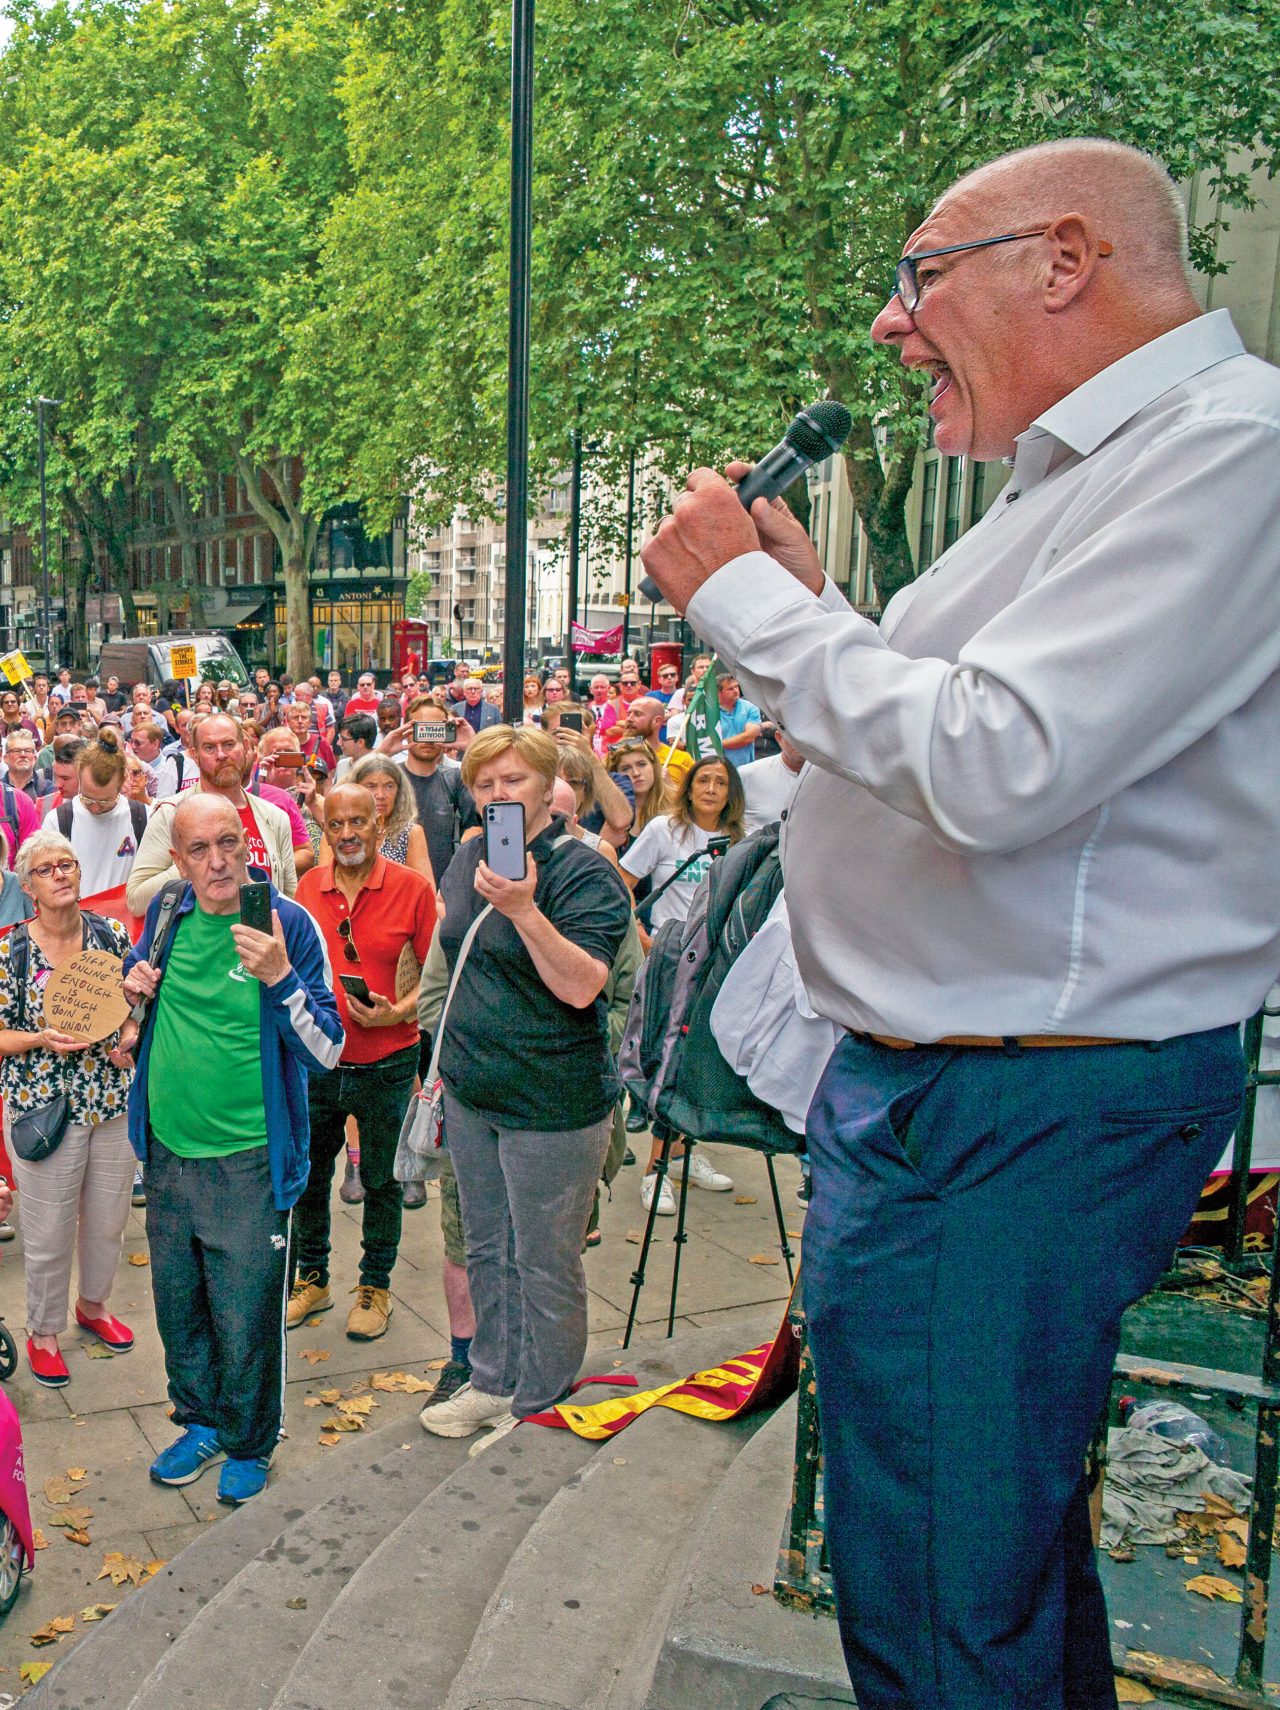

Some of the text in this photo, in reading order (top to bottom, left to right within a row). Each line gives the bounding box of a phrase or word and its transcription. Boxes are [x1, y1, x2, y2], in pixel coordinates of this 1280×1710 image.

[70, 962, 111, 981] ONLINE
[60, 974, 112, 999] ENOUGH
[68, 988, 78, 997] IS
[52, 992, 98, 1012] ENOUGH
[51, 1004, 91, 1022] JOIN A
[60, 1021, 92, 1032] UNION
